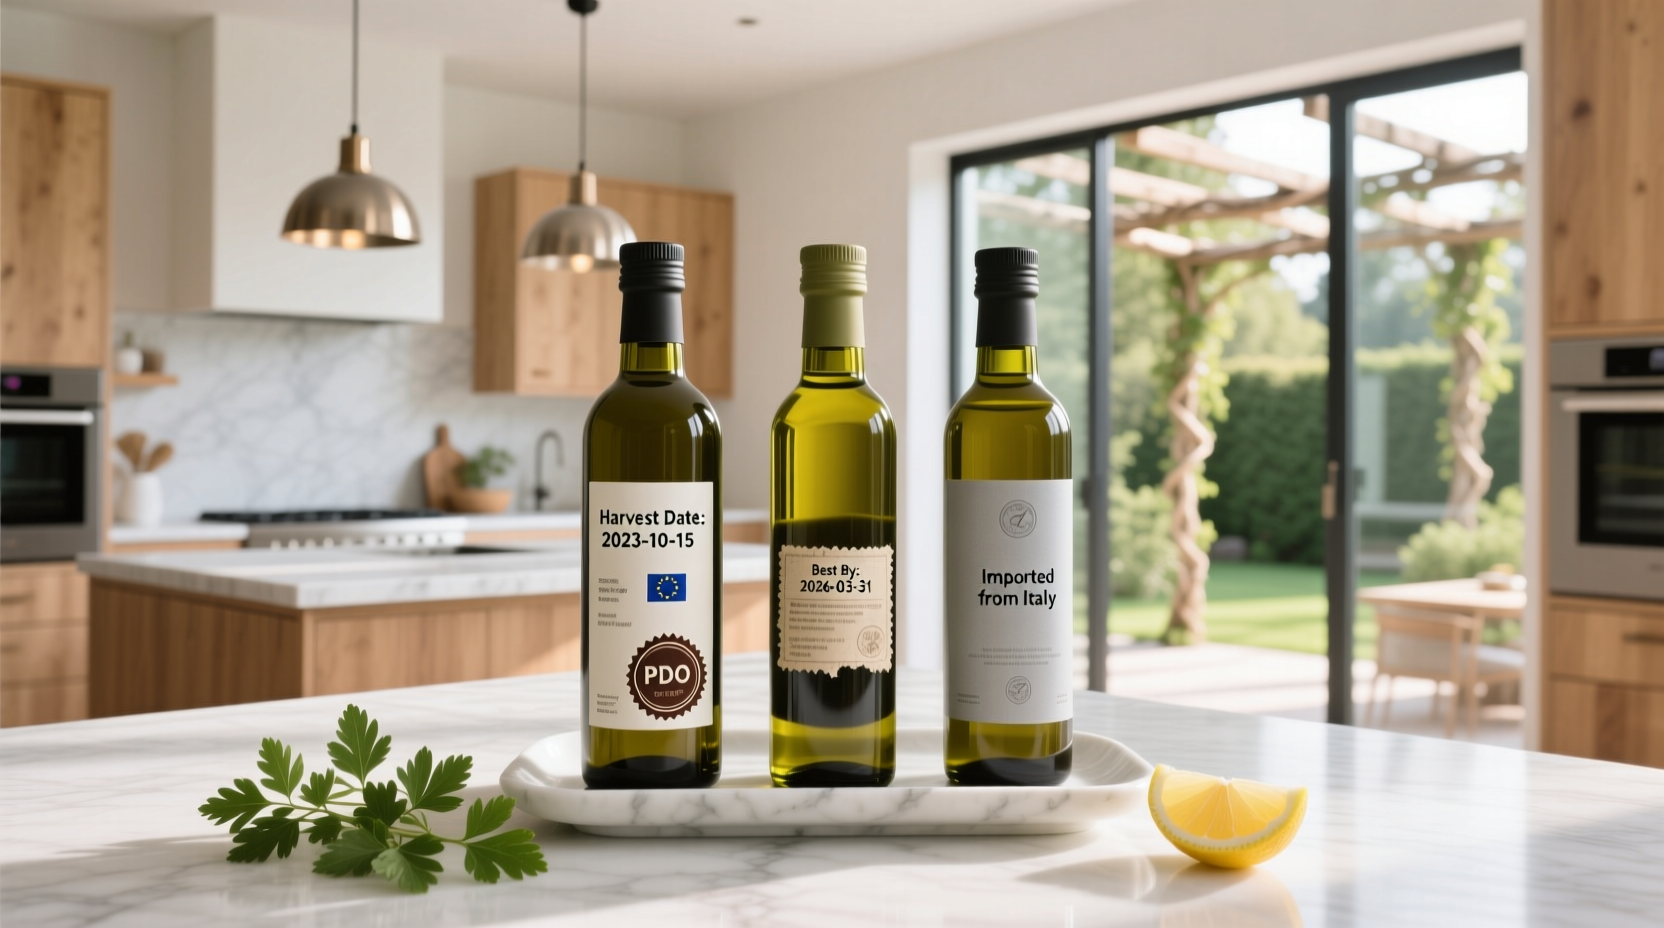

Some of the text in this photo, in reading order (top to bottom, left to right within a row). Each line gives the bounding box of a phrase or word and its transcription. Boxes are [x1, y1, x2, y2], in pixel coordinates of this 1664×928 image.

[600, 509, 705, 526] Harvest Date:
[601, 532, 694, 548] 2023-10-15
[812, 564, 860, 580] Best By:
[982, 568, 1054, 588] Imported
[800, 579, 871, 593] 2026-03-31
[978, 589, 1057, 610] from Italy
[644, 664, 691, 685] PDO
